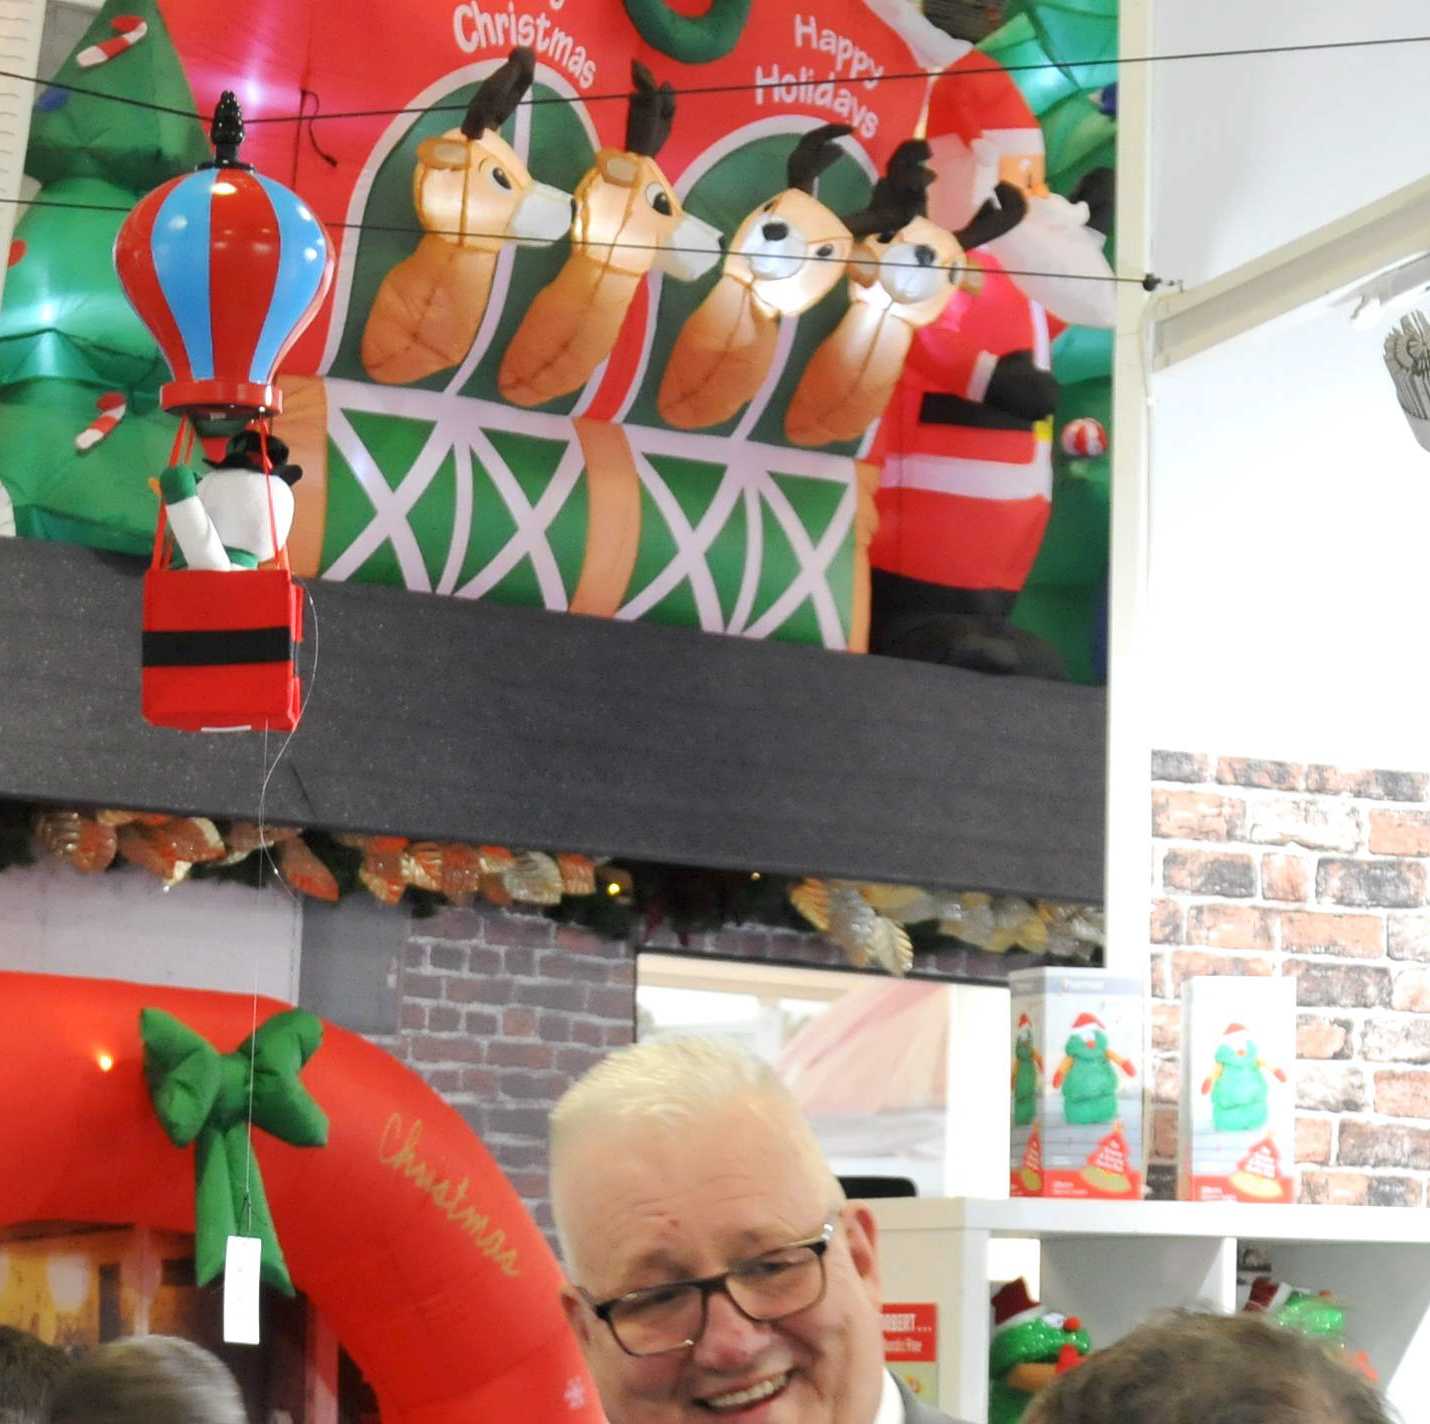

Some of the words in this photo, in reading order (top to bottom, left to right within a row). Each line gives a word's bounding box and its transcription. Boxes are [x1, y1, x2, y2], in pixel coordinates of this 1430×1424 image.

[453, 2, 596, 90] Christmas
[794, 14, 885, 90] Happy
[754, 64, 880, 139] Holidays
[380, 1112, 522, 1277] Christmas
